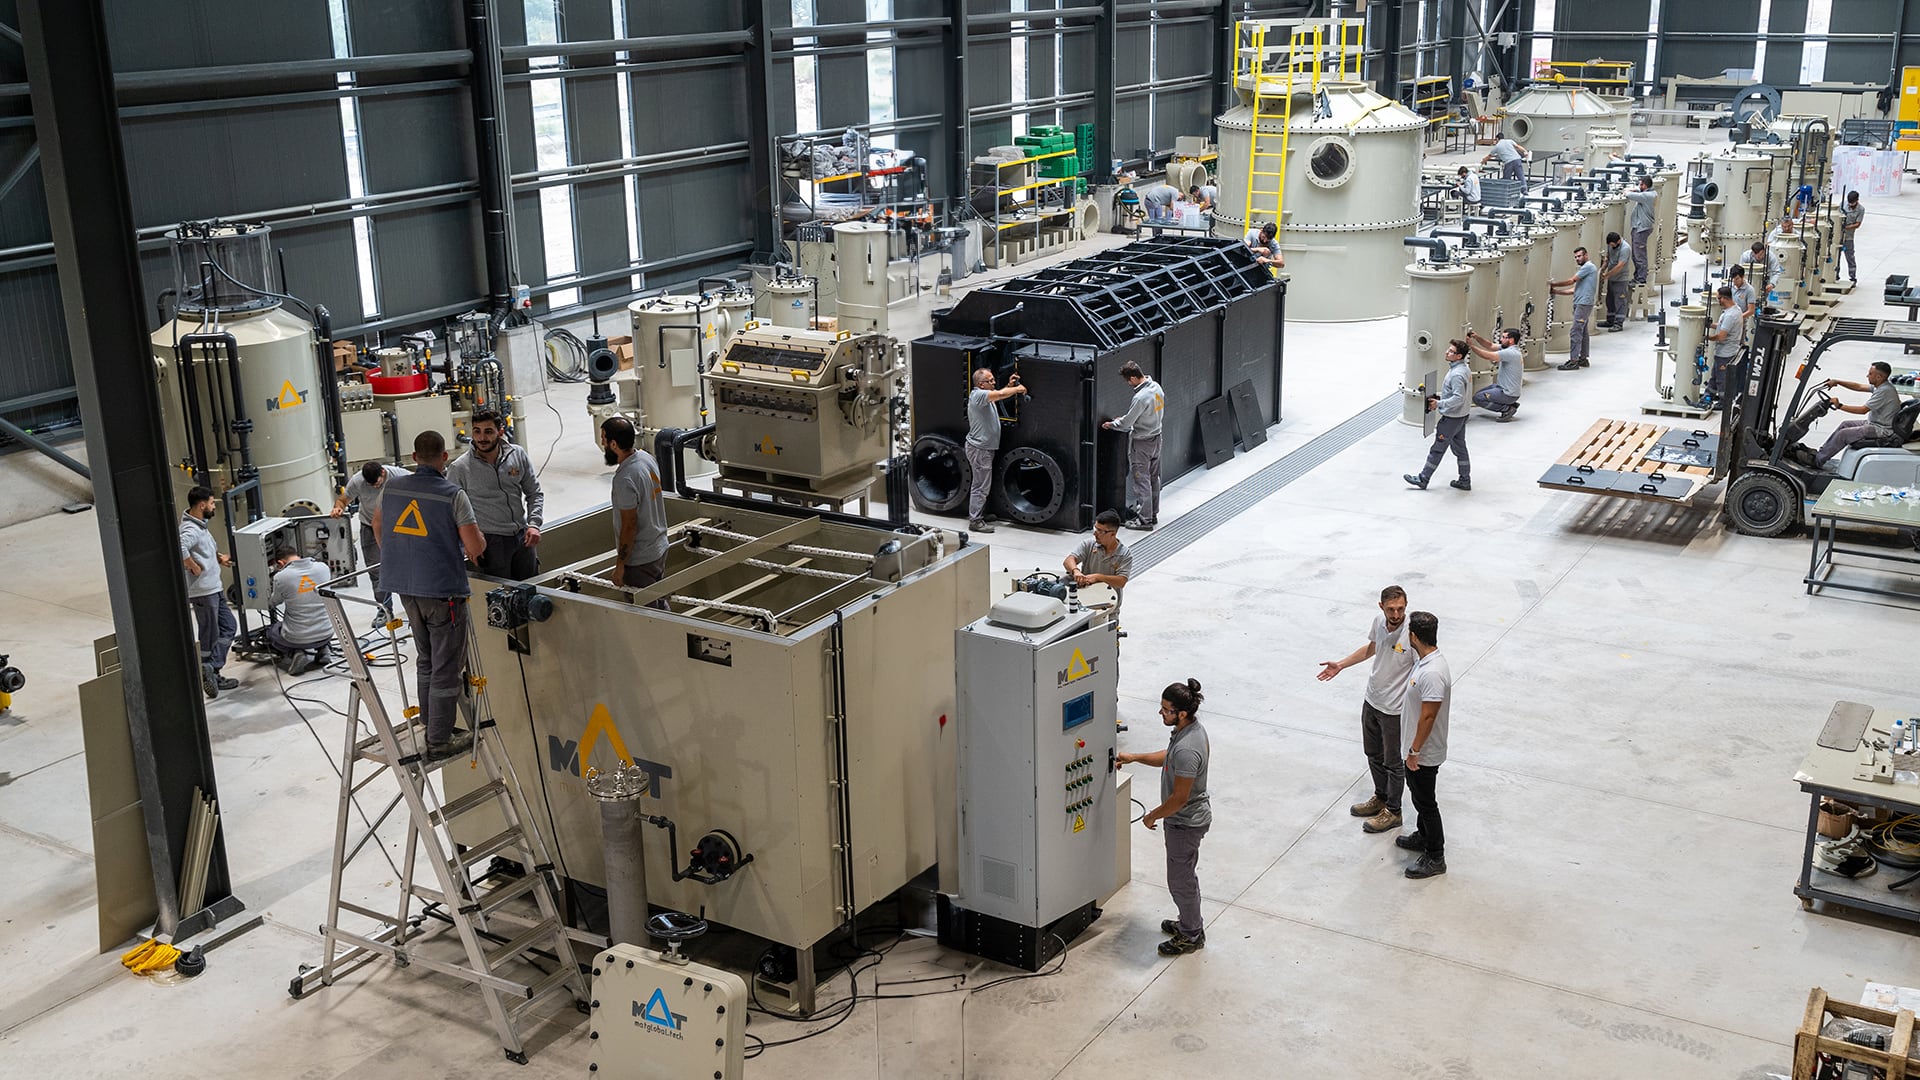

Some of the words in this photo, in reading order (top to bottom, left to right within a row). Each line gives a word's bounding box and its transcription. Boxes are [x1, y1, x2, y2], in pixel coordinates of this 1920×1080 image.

[1751, 347, 1766, 377] TCM
[266, 379, 309, 412] MAT
[1057, 647, 1099, 685] MAT
[548, 703, 672, 800] MAT
[631, 987, 688, 1031] MAT
